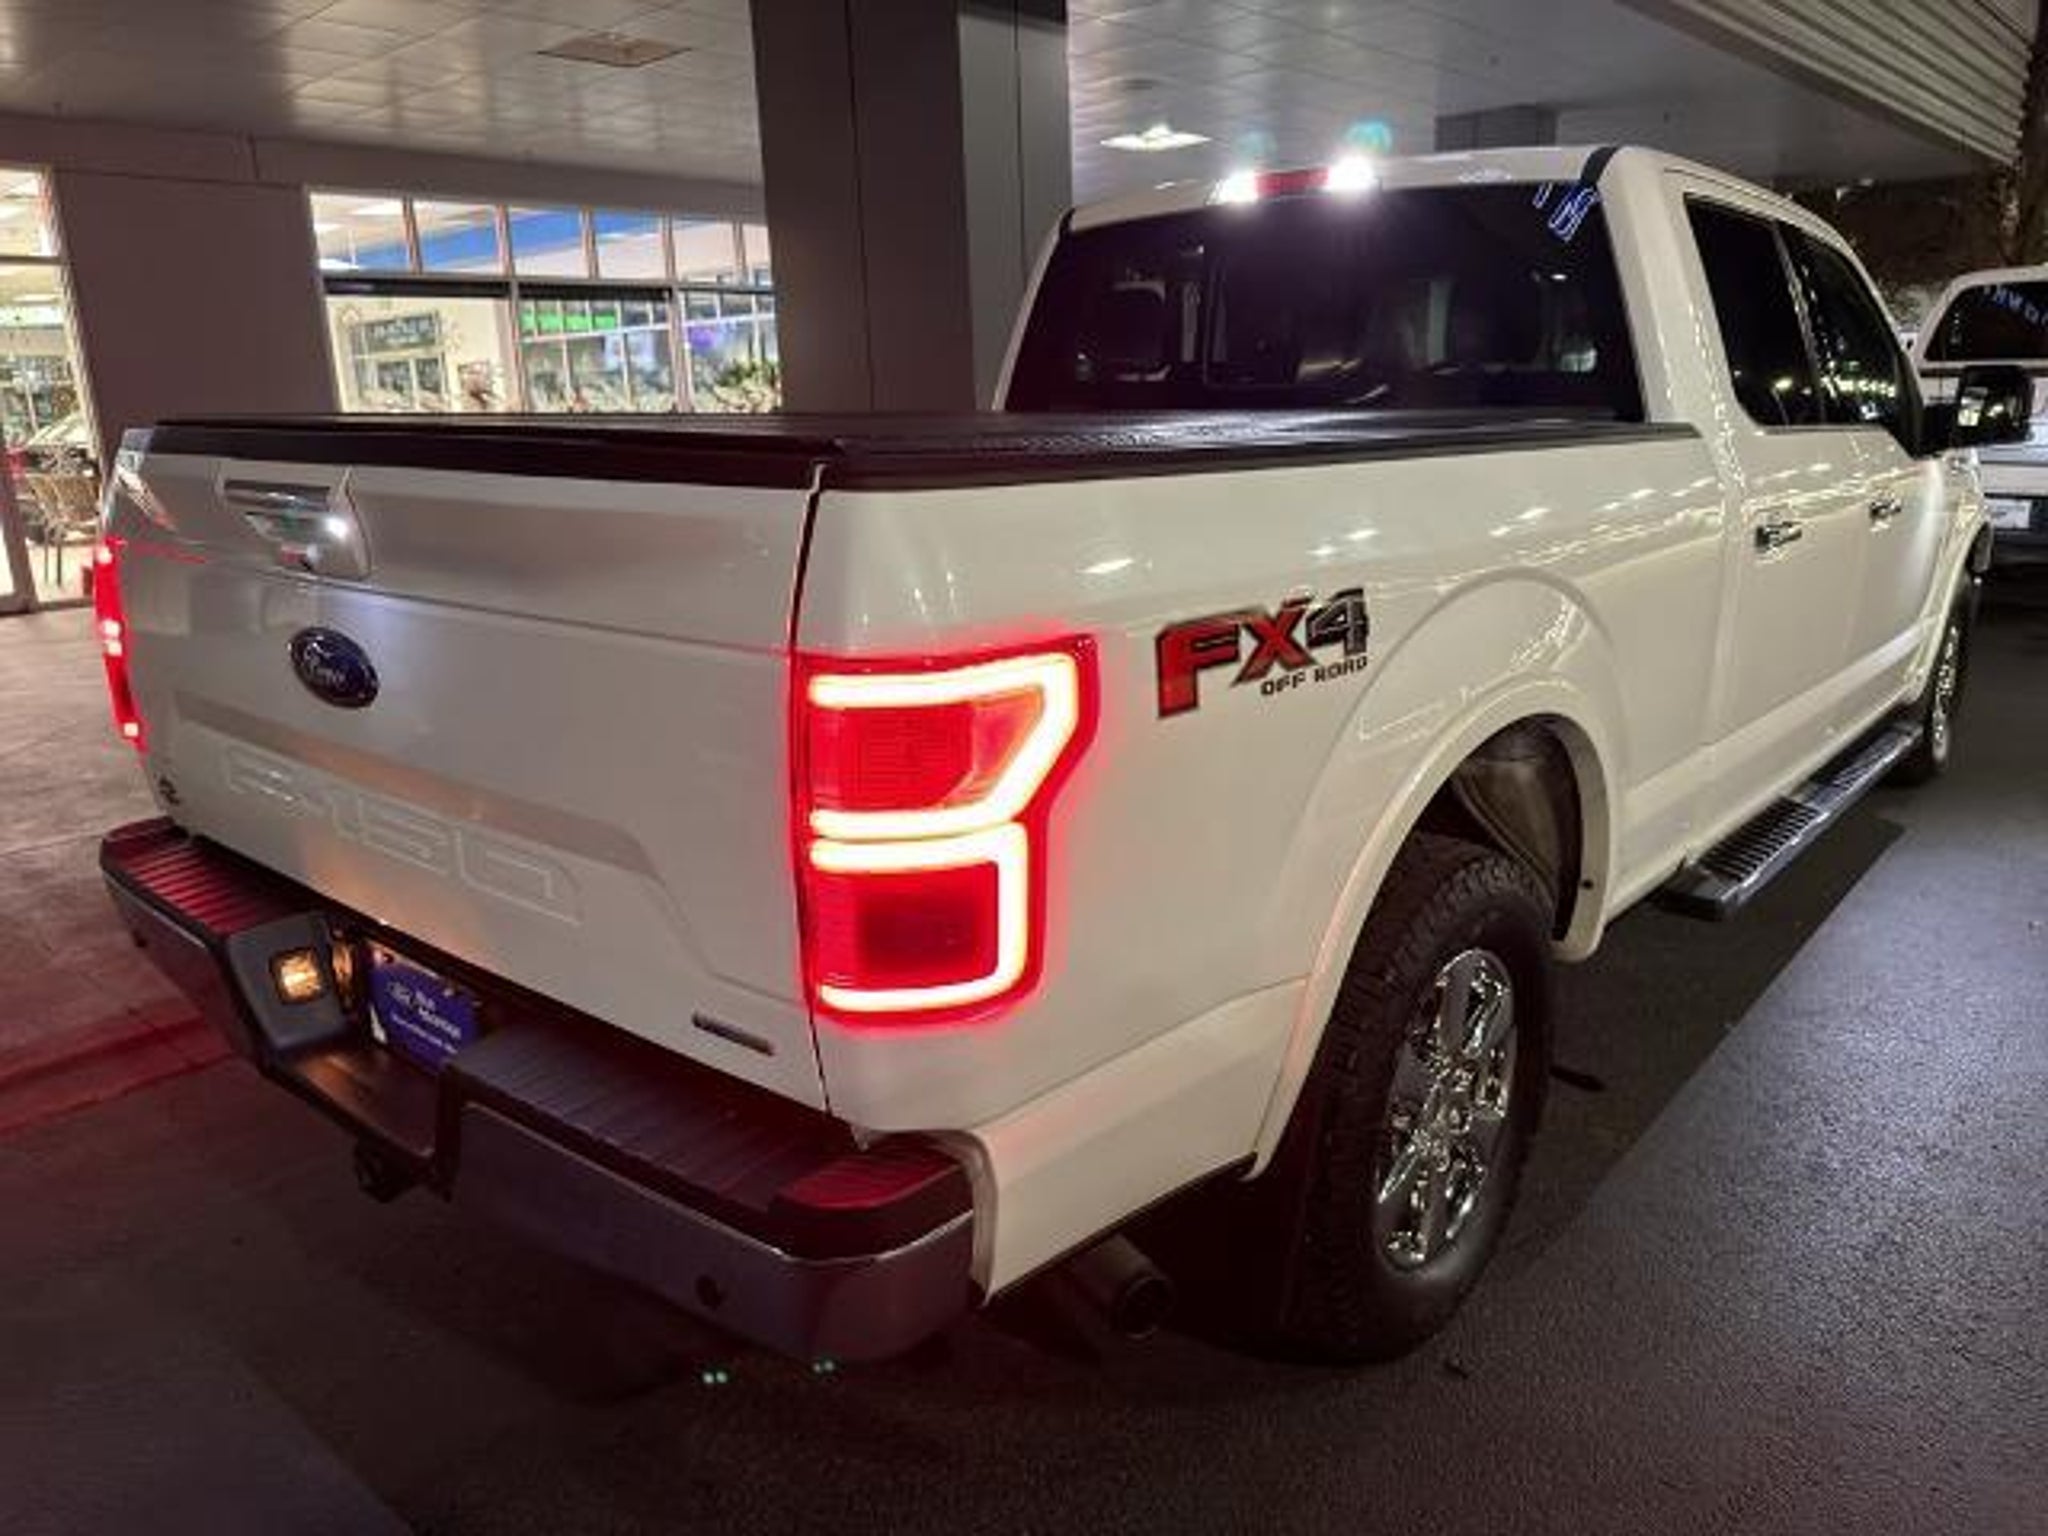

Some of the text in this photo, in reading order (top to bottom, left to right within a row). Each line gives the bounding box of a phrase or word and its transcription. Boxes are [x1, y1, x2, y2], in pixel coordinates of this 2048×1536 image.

[1155, 587, 1370, 719] FX4
[1260, 656, 1369, 696] OFF ROAD
